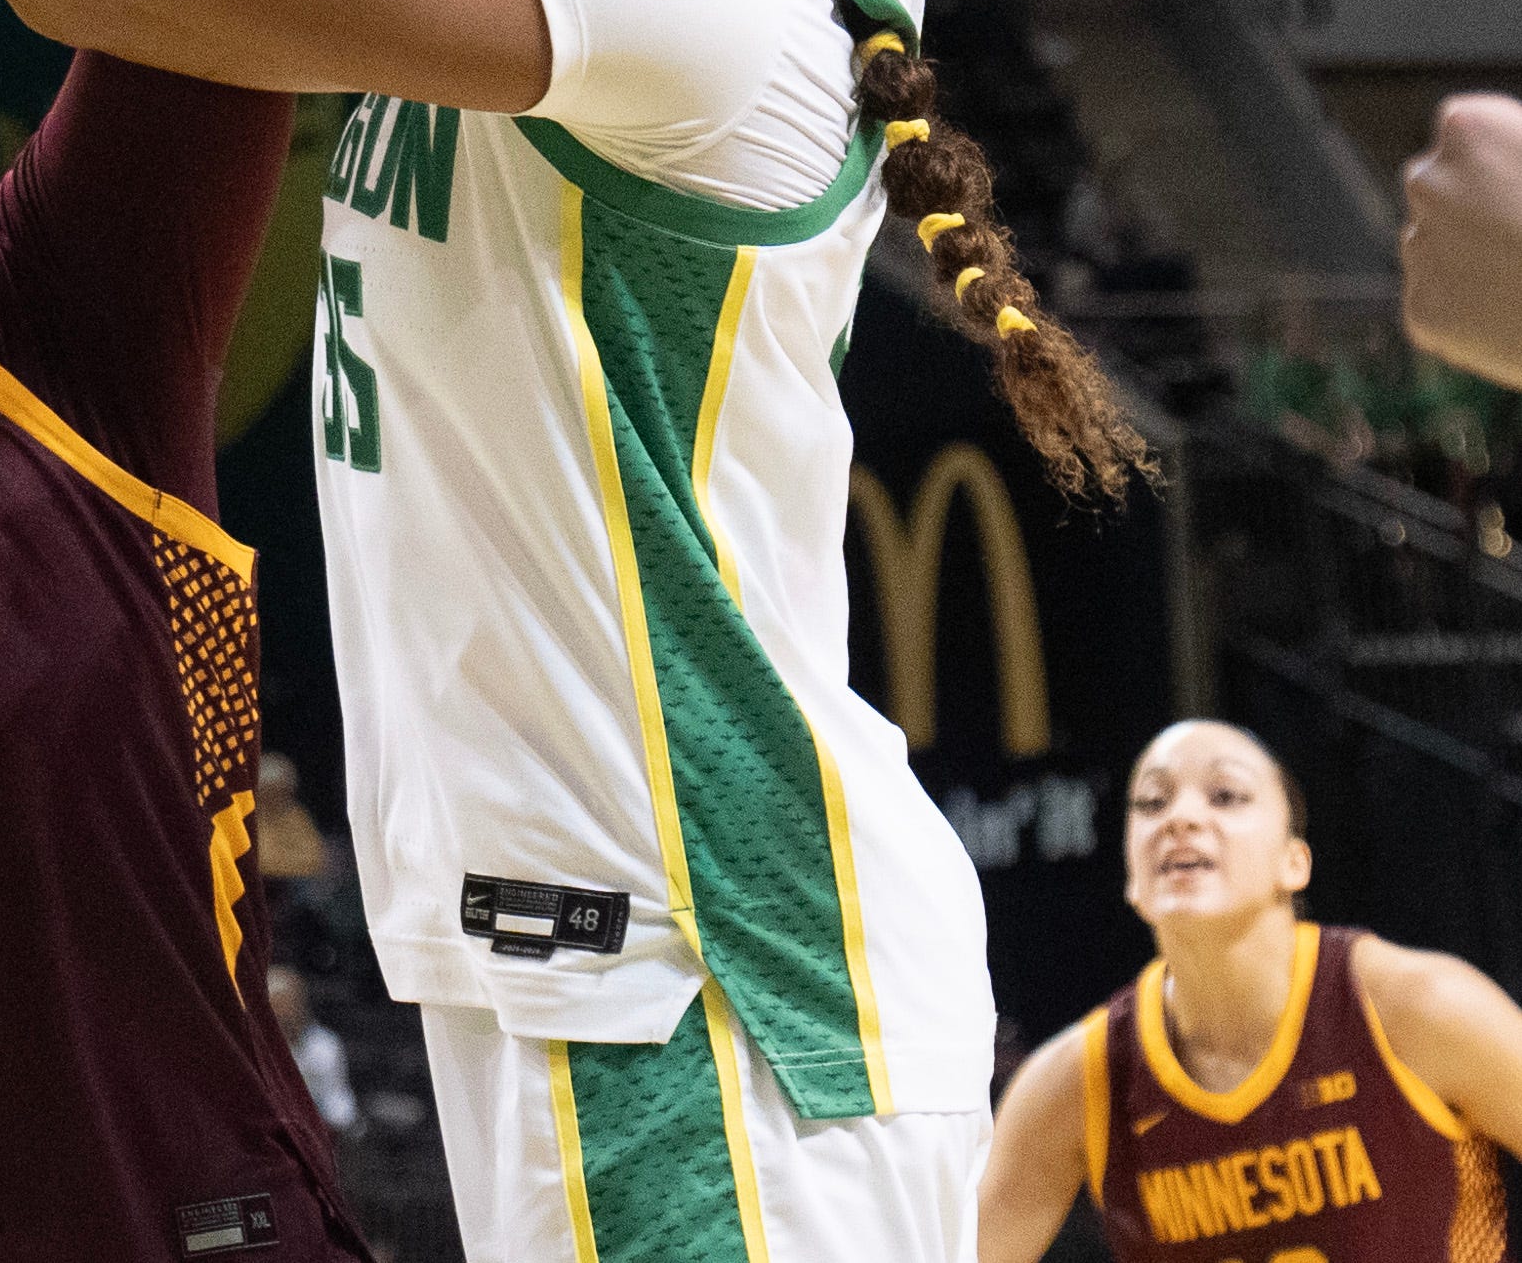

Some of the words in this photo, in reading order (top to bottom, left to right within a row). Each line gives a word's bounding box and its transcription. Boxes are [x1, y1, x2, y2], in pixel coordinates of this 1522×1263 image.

[326, 91, 461, 244] GON
[568, 907, 600, 932] 48
[1136, 1125, 1383, 1244] MINNESOTA
